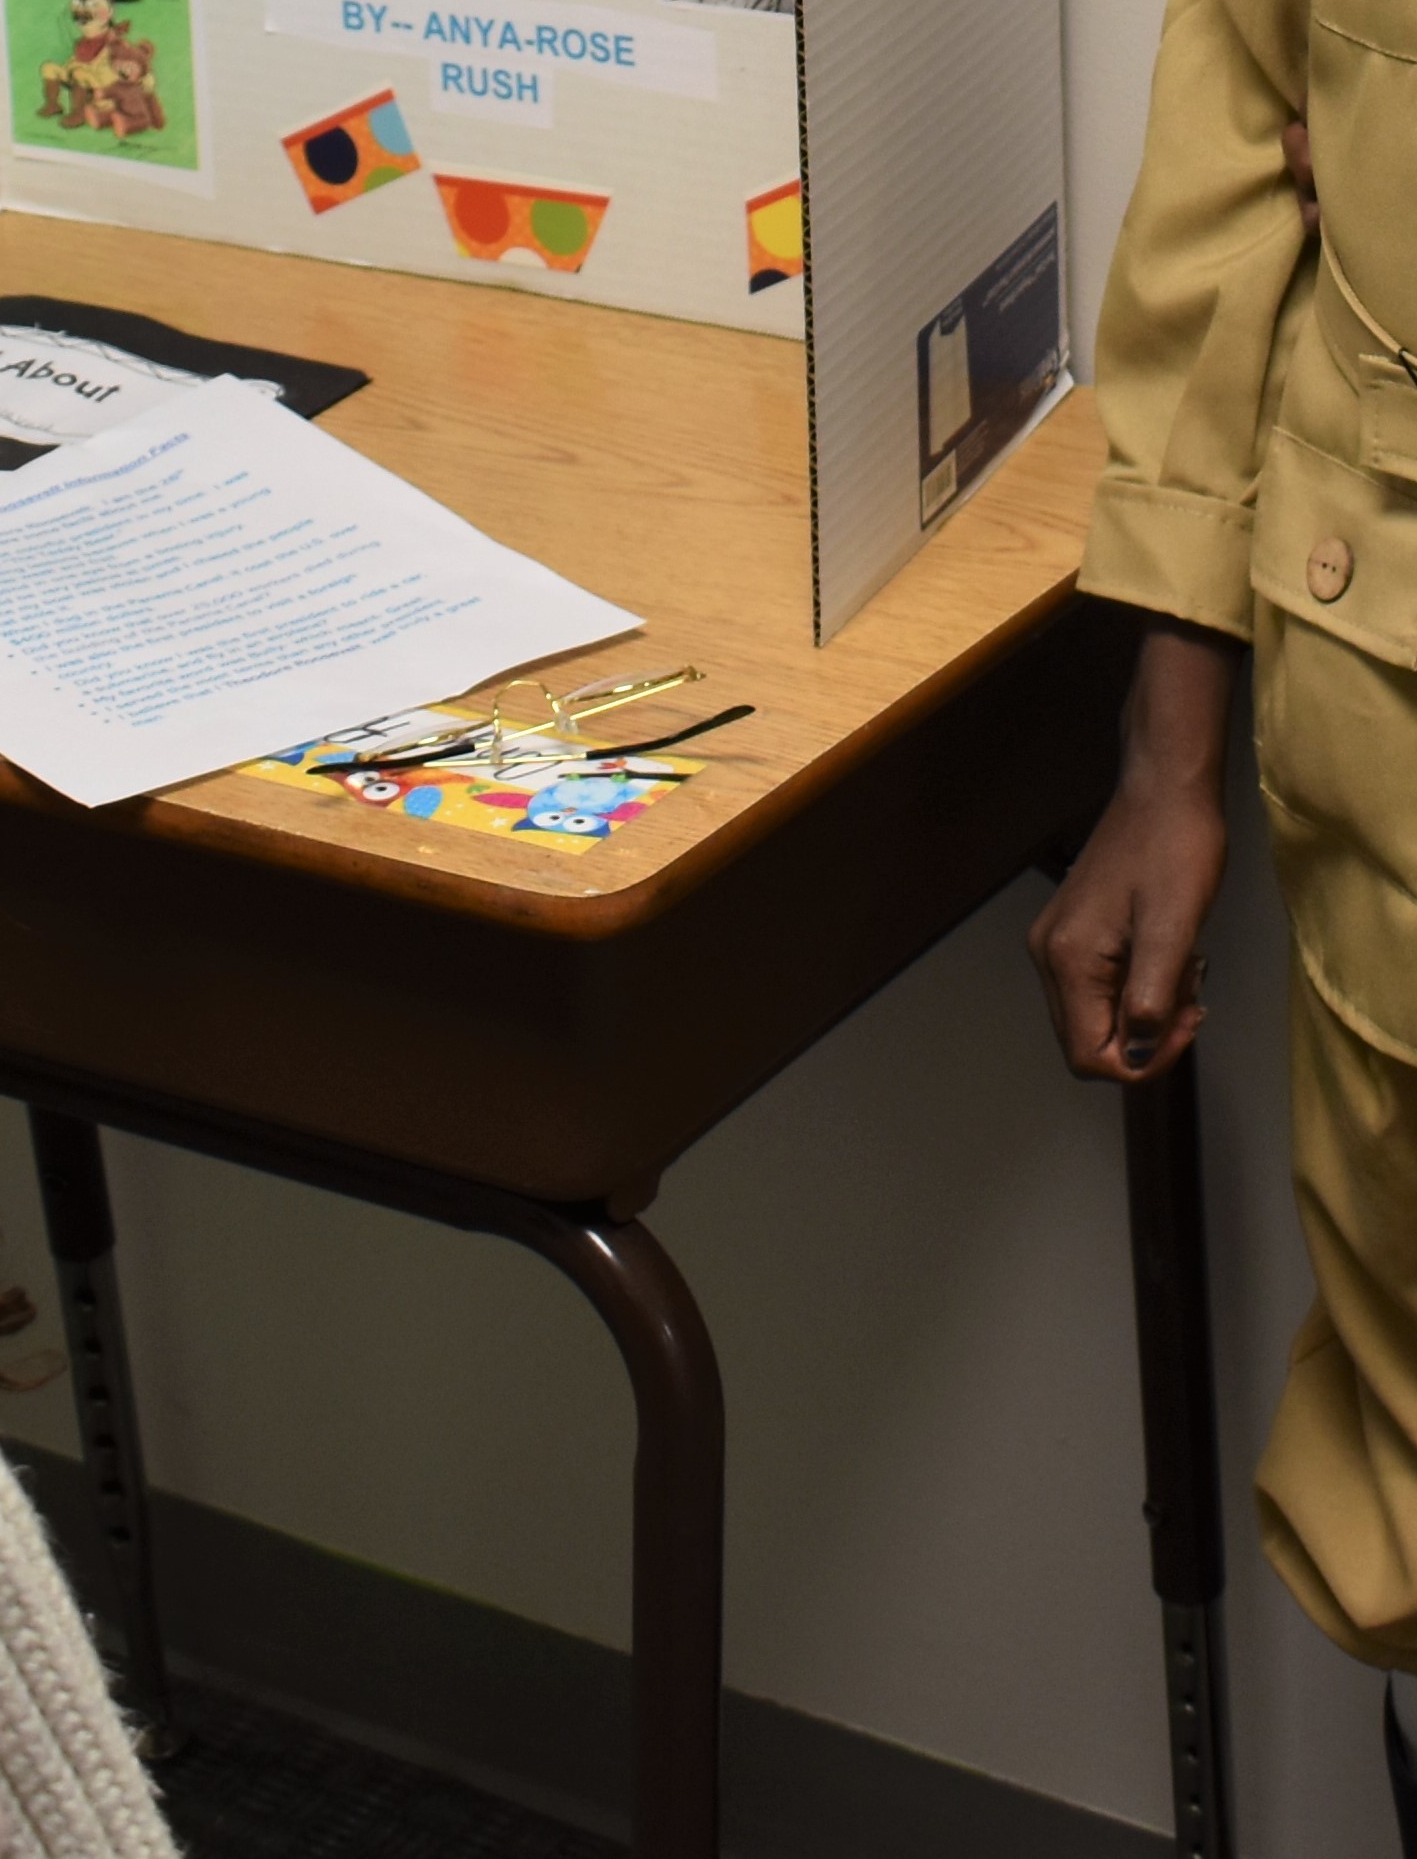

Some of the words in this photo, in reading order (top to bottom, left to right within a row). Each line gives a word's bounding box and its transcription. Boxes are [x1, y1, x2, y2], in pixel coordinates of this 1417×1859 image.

[342, 0, 413, 33] BY--
[423, 11, 635, 67] ANYA-ROSE
[441, 62, 539, 104] RUSH
